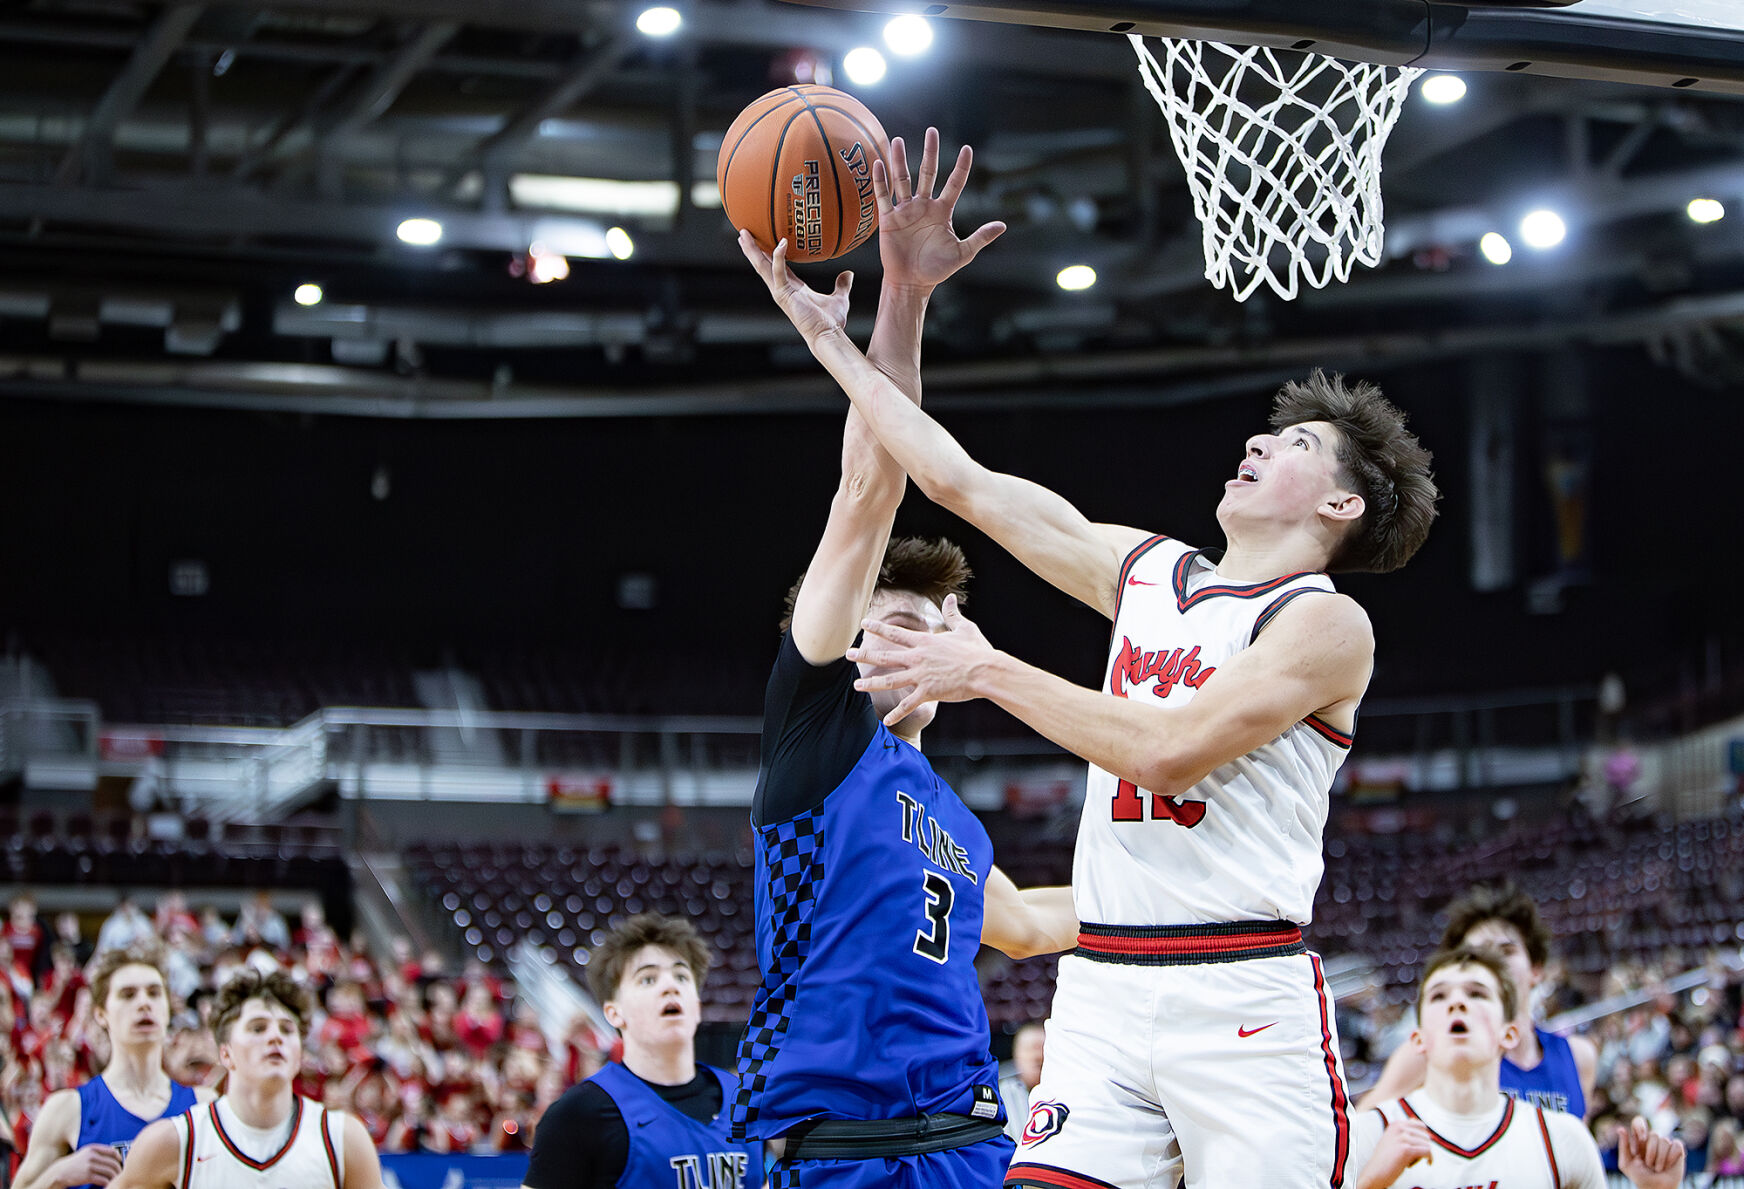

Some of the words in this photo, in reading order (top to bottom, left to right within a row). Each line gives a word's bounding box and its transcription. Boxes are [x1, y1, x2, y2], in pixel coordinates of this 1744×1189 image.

[794, 199, 806, 250] 1000
[803, 160, 822, 256] PRECISION
[896, 790, 978, 886] TLINE
[912, 867, 955, 965] 3
[982, 1086, 993, 1100] M
